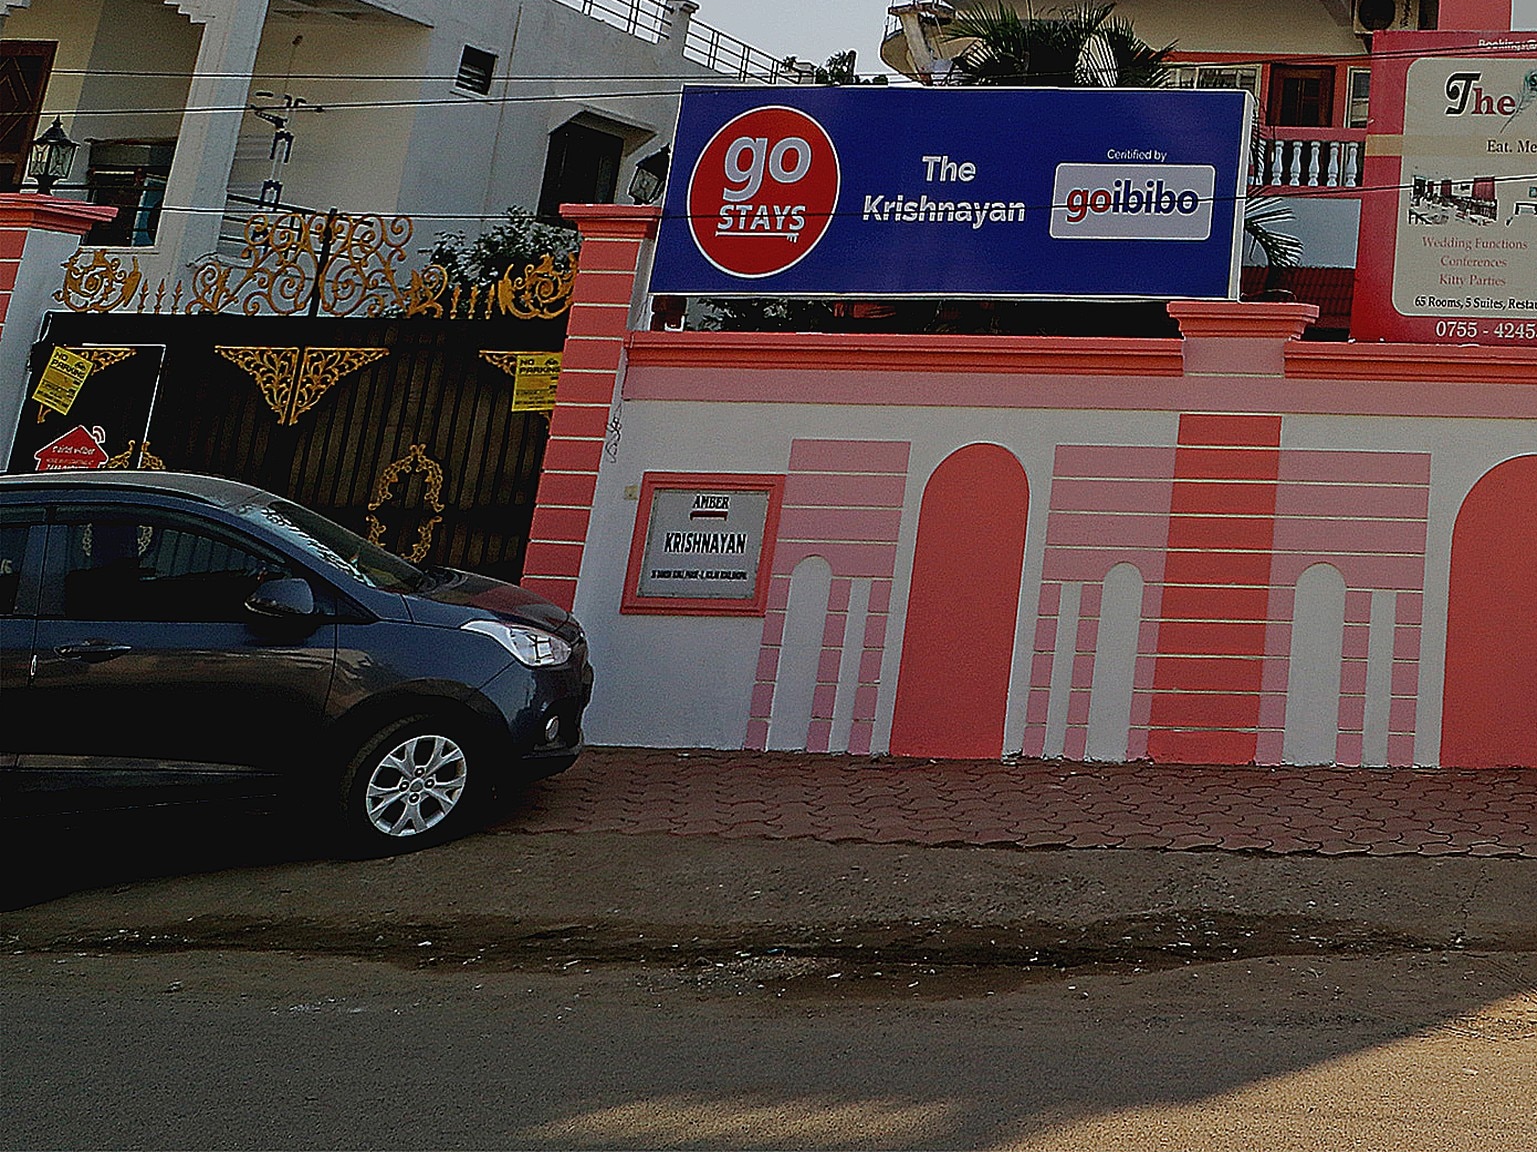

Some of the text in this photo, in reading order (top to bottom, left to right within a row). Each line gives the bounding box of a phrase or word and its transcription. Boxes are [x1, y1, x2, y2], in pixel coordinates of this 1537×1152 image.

[1444, 71, 1516, 116] The
[1486, 140, 1513, 153] Eat.
[1154, 150, 1168, 162] by
[722, 136, 812, 202] go
[922, 155, 977, 182] The
[1066, 179, 1199, 223] goibibo
[717, 204, 807, 231] STAYS
[862, 194, 1026, 230] Krishnayan
[1422, 236, 1528, 250] Wedding Functions
[1440, 255, 1508, 268] Conferences
[1439, 274, 1506, 288] Kitty Parties
[1415, 296, 1426, 306] 65
[1429, 297, 1464, 309] Rooms,
[1466, 297, 1472, 308] 5
[1474, 298, 1506, 311] Suites,
[1436, 321, 1478, 337] 0755
[53, 351, 69, 362] NO
[692, 496, 729, 510] AMBER
[664, 533, 747, 554] KRISHNAYAN
